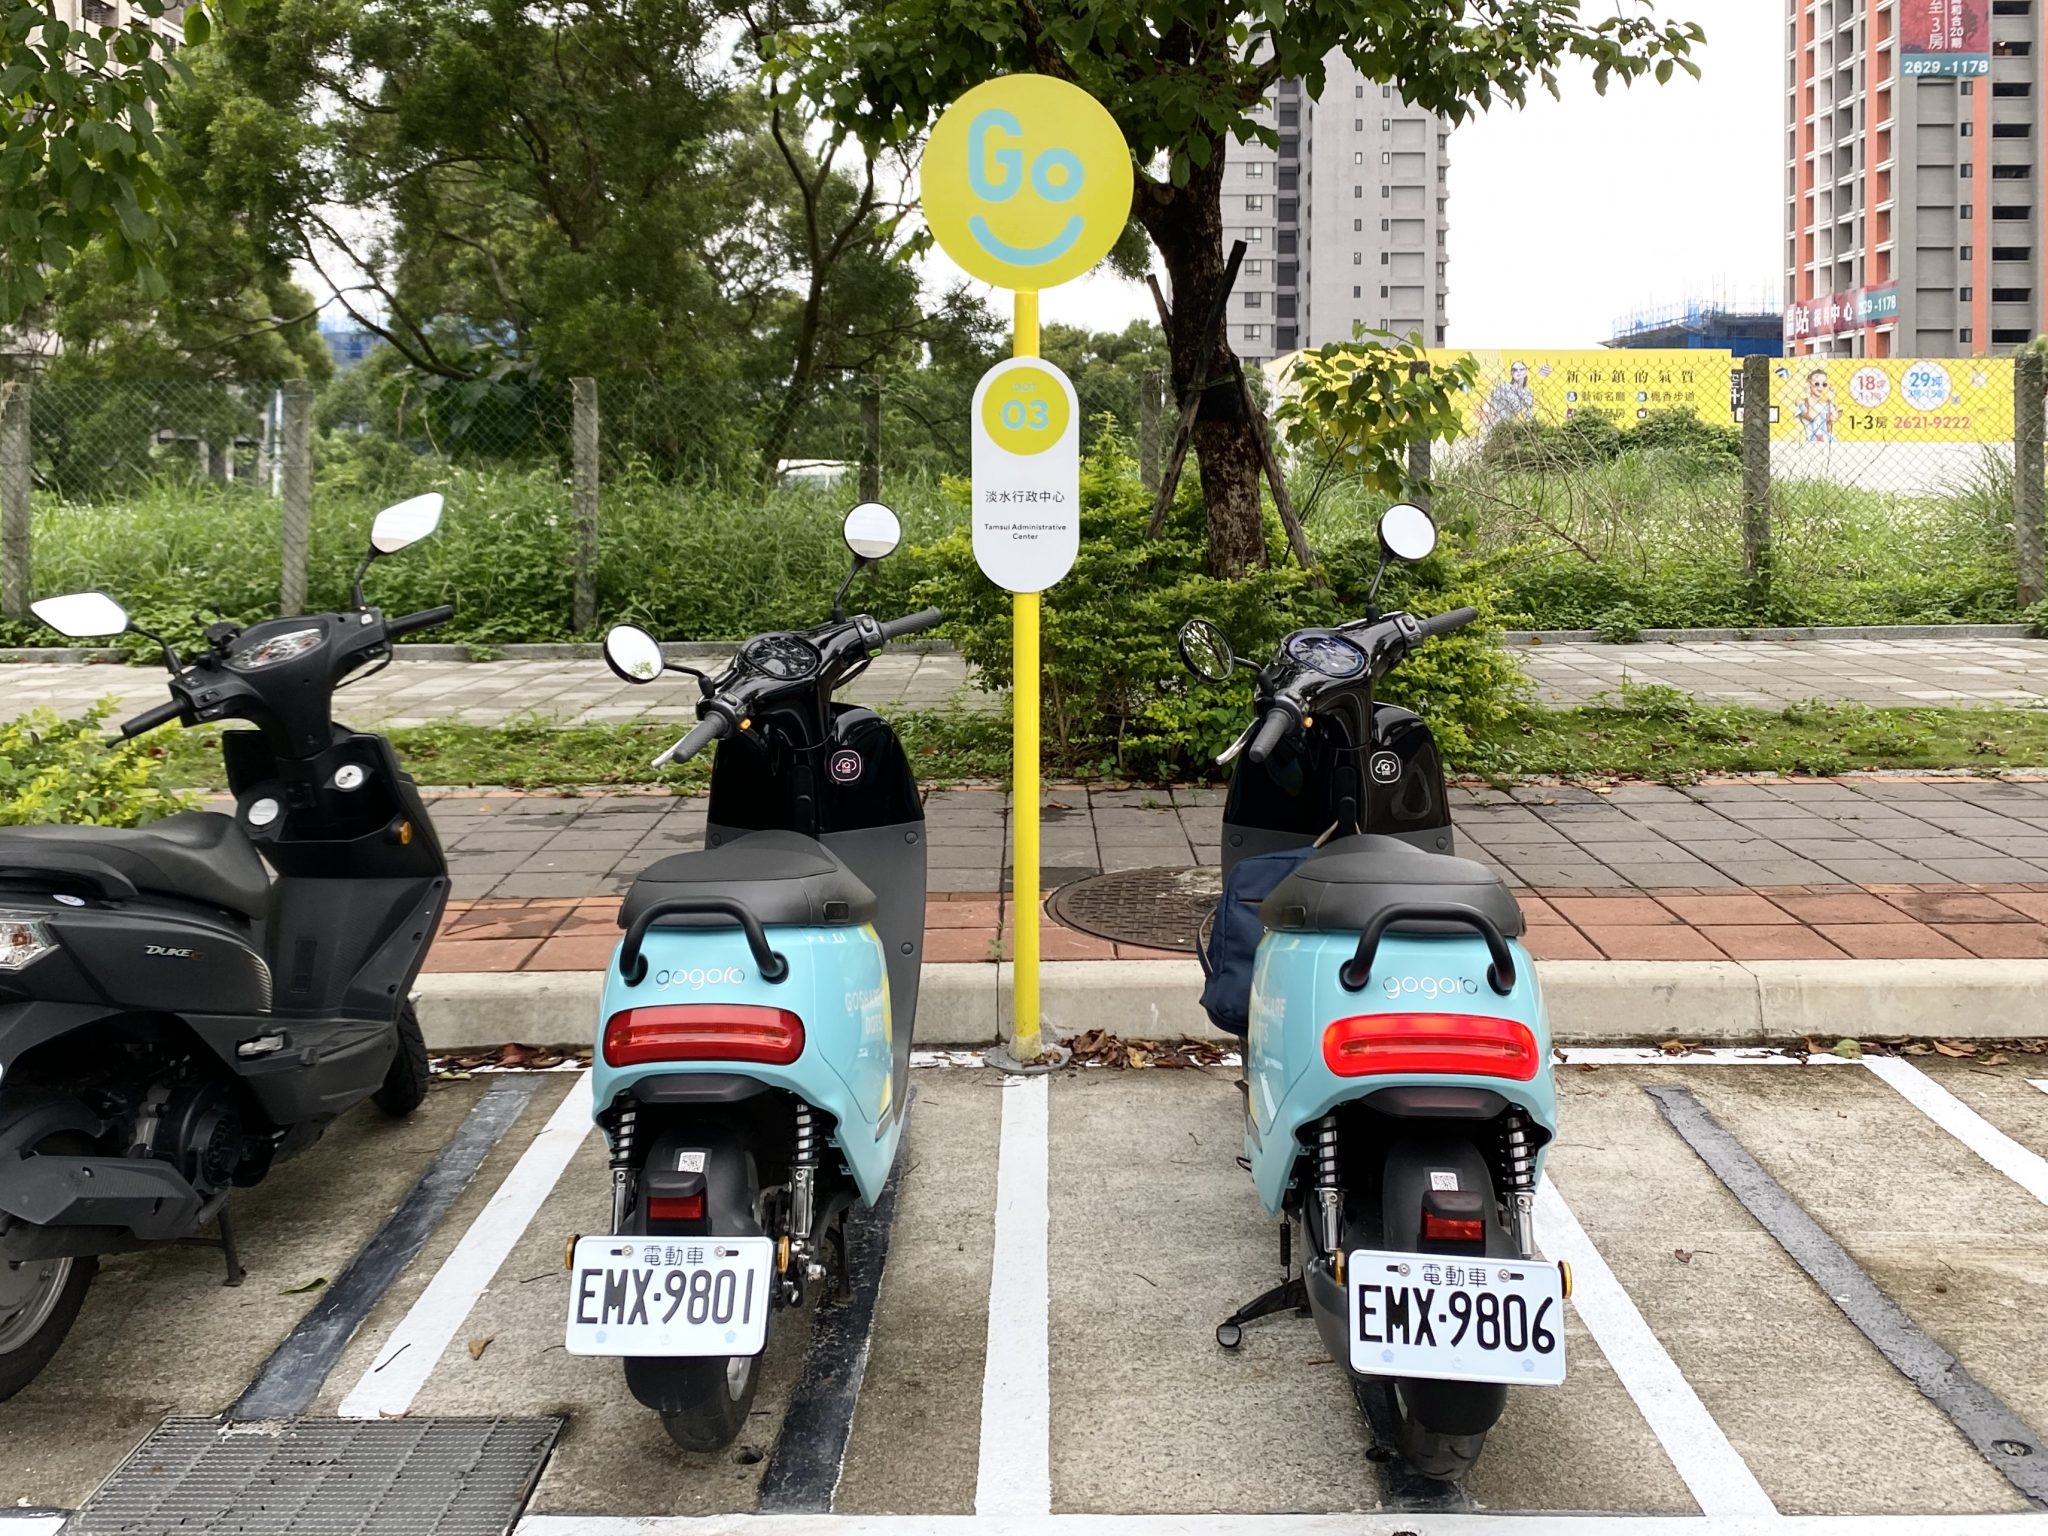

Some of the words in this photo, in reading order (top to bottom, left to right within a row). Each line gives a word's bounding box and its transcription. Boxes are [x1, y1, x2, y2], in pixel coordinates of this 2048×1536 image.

[1904, 60, 1988, 74] 2629-1178
[968, 108, 1085, 204] Go
[1001, 399, 1050, 431] 03
[1894, 416, 1972, 430] 2621-9222
[985, 490, 1065, 504] 淡水行政中心
[984, 523, 1010, 531] Tamsui
[1011, 523, 1067, 531] Administrative
[145, 945, 194, 957] DUKE
[656, 967, 745, 992] gogoro
[1383, 976, 1478, 1000] gogoro
[644, 1245, 704, 1267] 電動車
[1422, 1263, 1488, 1288] 電動車
